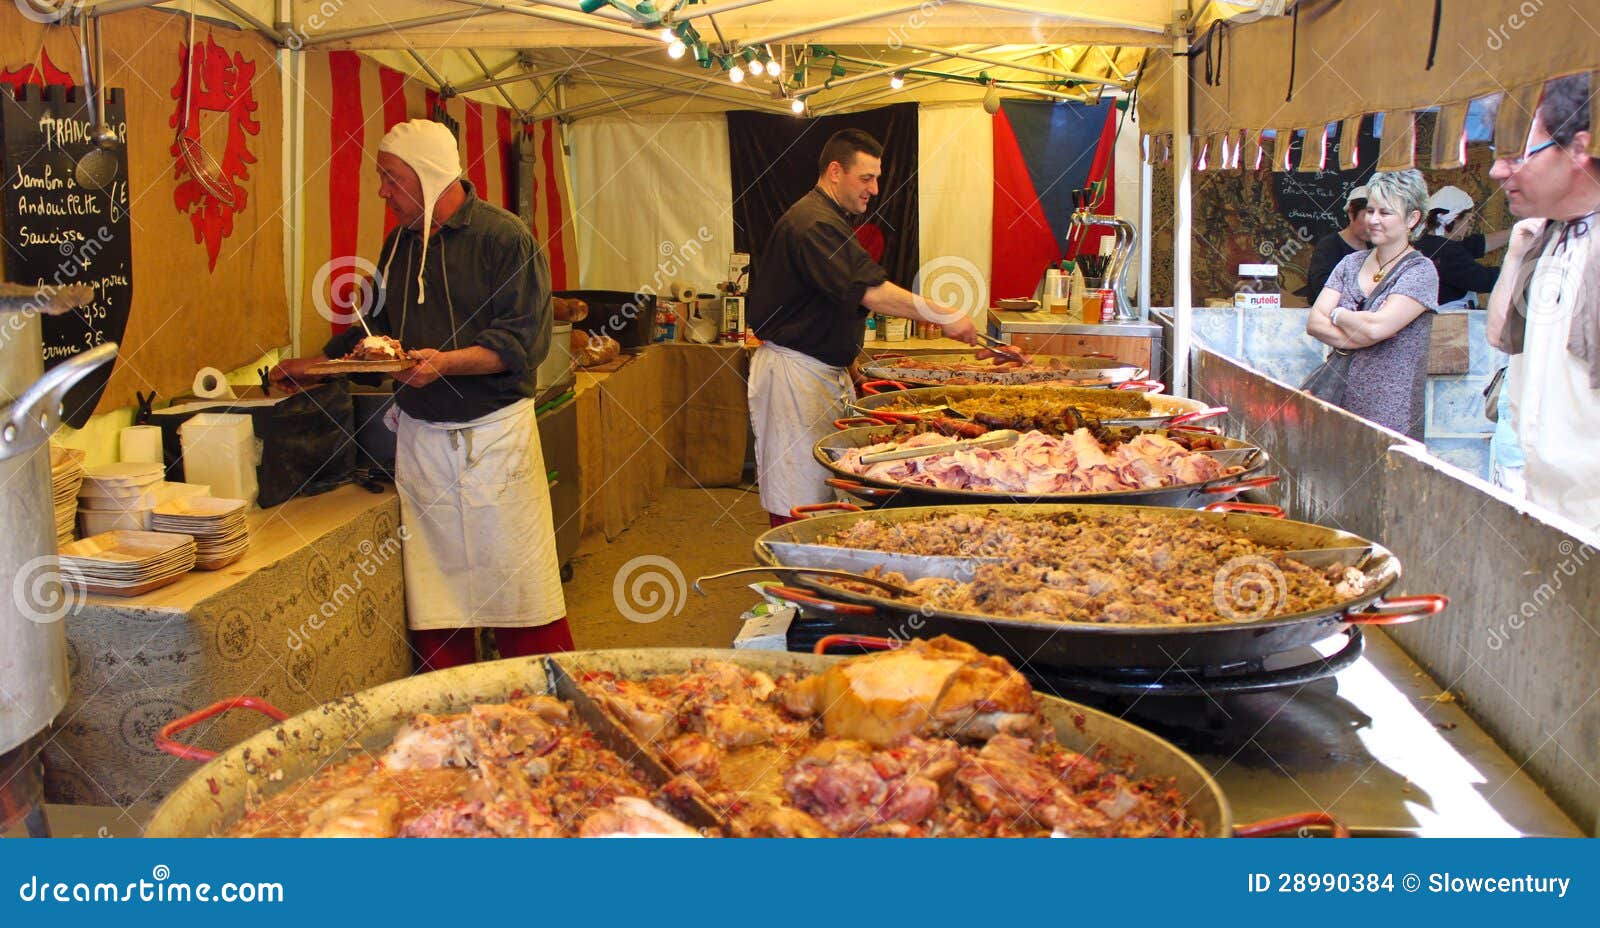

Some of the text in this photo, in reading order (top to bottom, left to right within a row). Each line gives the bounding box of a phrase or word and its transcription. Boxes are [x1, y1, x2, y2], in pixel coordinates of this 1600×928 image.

[13, 164, 63, 190] Jambon
[18, 194, 102, 216] Andouillette
[19, 226, 85, 247] Saucisse
[1250, 295, 1279, 305] nutella
[42, 334, 80, 361] errine
